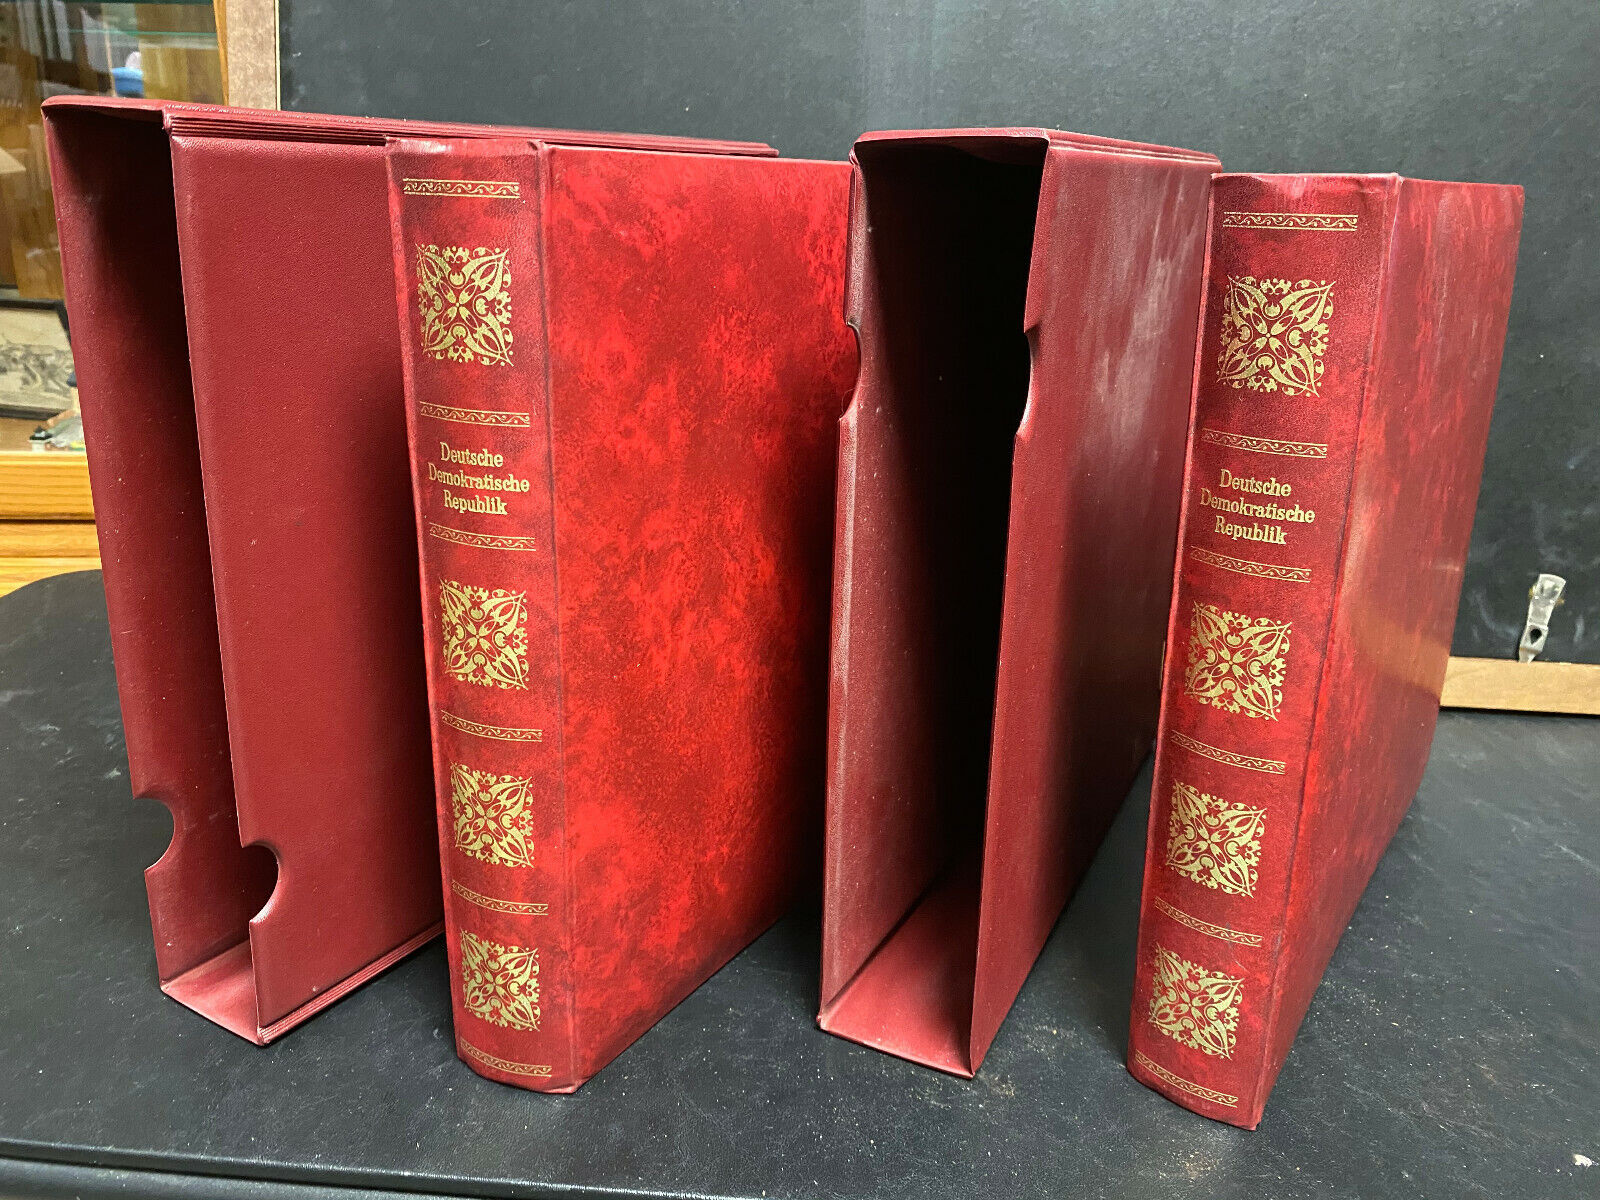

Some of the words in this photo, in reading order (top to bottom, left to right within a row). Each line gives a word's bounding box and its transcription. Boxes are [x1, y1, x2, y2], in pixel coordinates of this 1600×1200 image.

[440, 441, 503, 467] Deutsche
[428, 462, 530, 492] Demokratische
[1219, 468, 1292, 497] Deutsche
[443, 489, 508, 515] Republik
[1200, 487, 1316, 523] Demokratische
[1214, 515, 1287, 544] Republik
